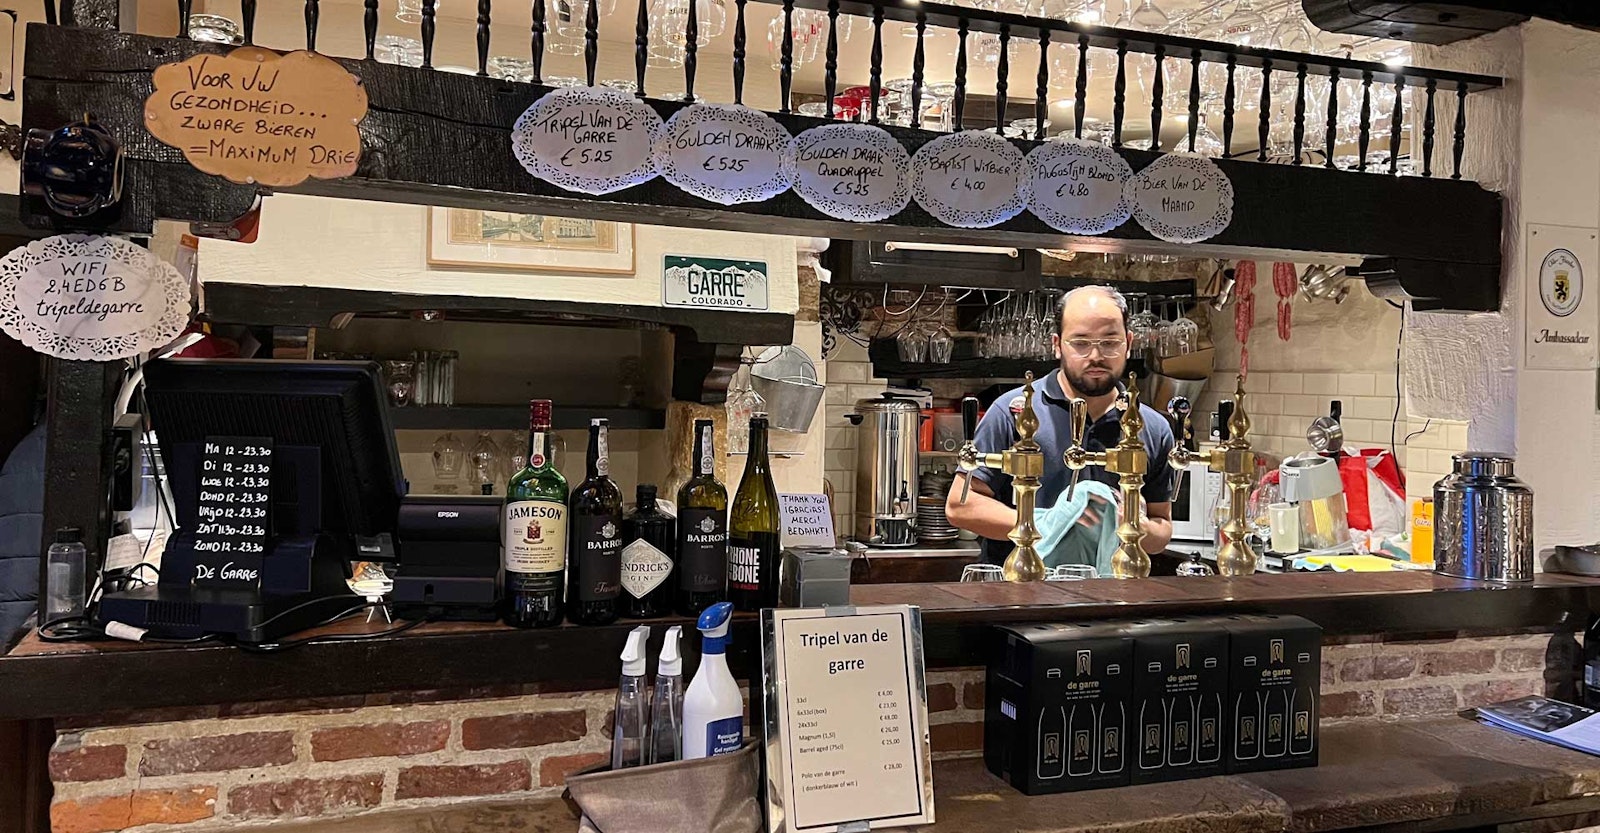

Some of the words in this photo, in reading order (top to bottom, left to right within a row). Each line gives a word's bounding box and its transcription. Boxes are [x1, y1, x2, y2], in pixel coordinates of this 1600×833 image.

[187, 56, 233, 91] VOOR
[181, 116, 245, 134] ZWARE
[255, 119, 317, 139] BIEREN
[537, 108, 588, 139] TRIPEL
[589, 109, 612, 129] VAN
[616, 117, 634, 132] DE
[573, 129, 617, 144] GARRE
[675, 129, 731, 150] GULDEN
[734, 132, 775, 152] DRAAK
[310, 145, 355, 165] DRIE
[561, 149, 575, 168] €
[579, 150, 613, 164] 5.25
[800, 140, 849, 161] GULDEN
[852, 147, 885, 165] DRAAK
[702, 155, 715, 171] €
[928, 153, 972, 175] BAPTIST
[972, 158, 1011, 176] WITBIER
[817, 162, 884, 183] QUADRUPPEL
[1038, 159, 1086, 181] AUGUSTIJN
[1087, 167, 1116, 183] BLOND
[833, 182, 845, 195] €
[951, 179, 959, 190] €
[1142, 176, 1169, 191] BIER
[1171, 174, 1189, 191] VAN
[1191, 177, 1208, 191] DE
[1056, 183, 1065, 198] €
[1161, 197, 1196, 213] MAAND
[61, 261, 108, 276] WIFI
[687, 271, 746, 298] GARRE
[691, 297, 744, 307] COLORADO
[36, 297, 144, 323] tripeldegarre
[1534, 328, 1590, 344] Ambassadeur
[205, 443, 220, 454] MA
[201, 477, 223, 487] WOE
[200, 491, 225, 501] DOND
[781, 495, 810, 504] THANK
[508, 506, 563, 520] JAMESON
[791, 516, 821, 525] MERCI!
[196, 523, 218, 534] ZAT
[787, 527, 829, 537] BEDANKT!
[194, 540, 221, 551] ZOND
[687, 533, 725, 543] BARROS
[195, 564, 216, 580] DE
[220, 562, 259, 581] GARRE
[732, 564, 760, 584] BONE
[800, 631, 840, 649] Tripel
[843, 633, 868, 644] van
[871, 629, 888, 642] de
[829, 659, 865, 674] garre
[1261, 669, 1271, 677] de
[1272, 669, 1292, 678] garre
[1067, 681, 1078, 690] de
[1079, 680, 1100, 691] garre
[1167, 675, 1177, 683] de
[1178, 674, 1198, 683] garre
[816, 745, 829, 753] aged
